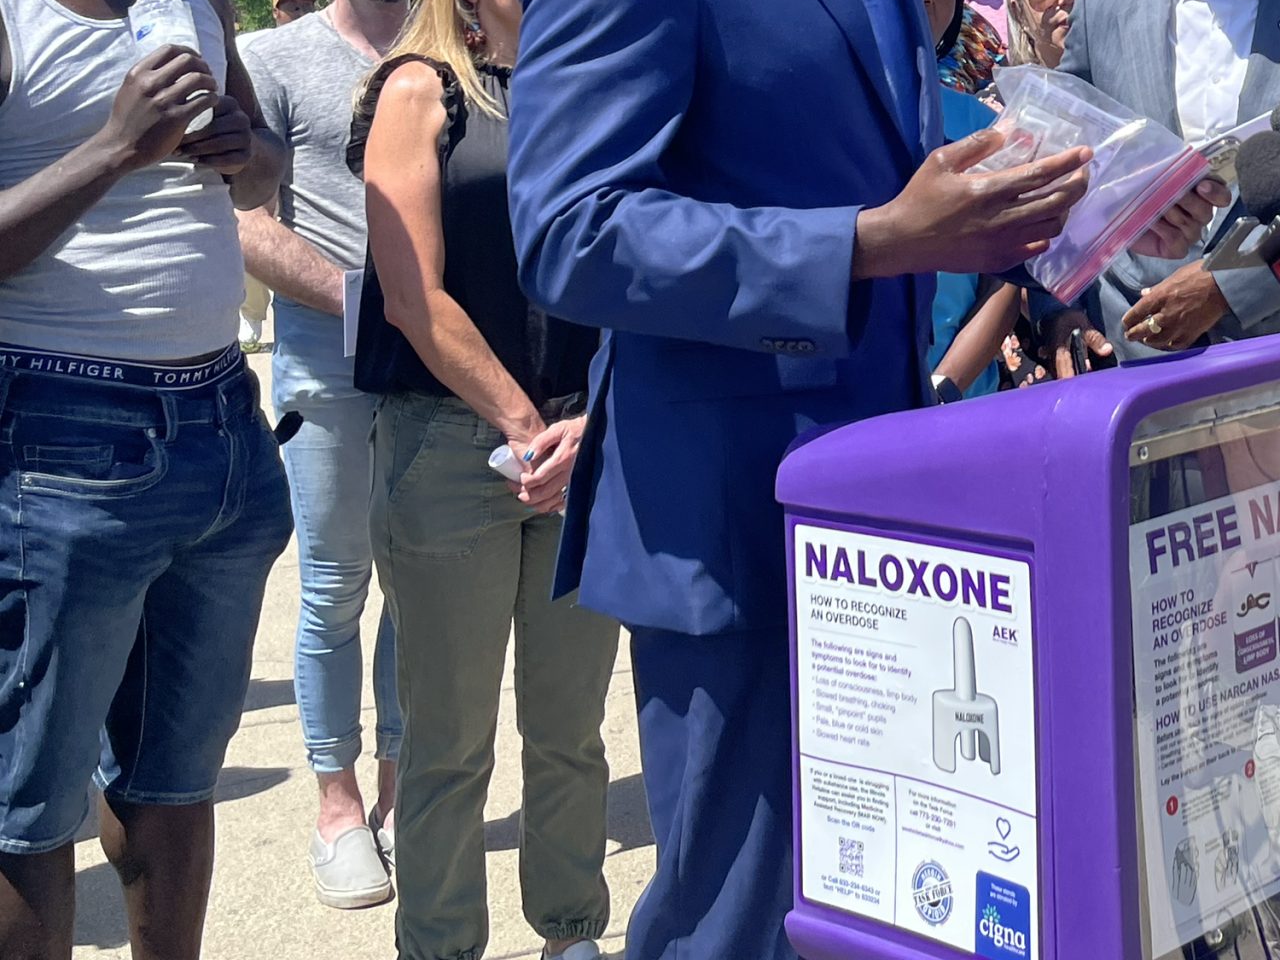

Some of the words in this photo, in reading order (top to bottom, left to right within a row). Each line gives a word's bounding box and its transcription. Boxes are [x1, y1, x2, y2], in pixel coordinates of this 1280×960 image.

[30, 358, 124, 380] HILFIGER
[153, 366, 210, 384] TOMMY
[1145, 504, 1242, 575] FREE
[805, 541, 1013, 615] NALOXONE
[811, 594, 833, 608] HOW
[835, 598, 849, 611] TO
[851, 601, 908, 621] RECOGNIZE
[1151, 594, 1178, 616] HOW
[1180, 589, 1195, 605] TO
[811, 609, 824, 622] AN
[826, 612, 880, 631] OVERDOSE
[1152, 599, 1214, 633] RECOGNIZE
[993, 625, 1018, 642] AEK
[1153, 633, 1169, 651] AN
[1171, 611, 1228, 643] OVERDOSE
[811, 637, 822, 649] The
[824, 640, 853, 656] following
[854, 647, 865, 656] are
[866, 649, 883, 660] signs
[885, 653, 897, 663] and
[1257, 648, 1270, 660] BODY
[812, 651, 844, 664] symptoms
[845, 656, 852, 665] to
[853, 658, 867, 668] look
[869, 661, 878, 670] for
[879, 663, 887, 672] to
[888, 665, 912, 679] identify
[817, 664, 844, 674] potential
[1154, 658, 1166, 669] The
[1155, 668, 1172, 682] signs
[816, 676, 830, 686] Loss
[831, 678, 837, 687] of
[887, 689, 900, 701] limp
[901, 692, 918, 706] body
[1155, 684, 1163, 694] to
[1163, 678, 1178, 691] look
[816, 688, 838, 701] Slowed
[871, 700, 897, 715] choking
[1156, 710, 1180, 731] HOW
[1184, 704, 1197, 719] TO
[1199, 696, 1218, 713] USE
[1220, 680, 1260, 704] NARCAN
[832, 719, 846, 729] blue
[855, 724, 869, 734] cold
[870, 727, 884, 736] skin
[868, 713, 887, 724] pupils
[955, 712, 985, 724] NALOXONE
[816, 728, 839, 741] Slowed
[840, 734, 856, 745] heart
[858, 738, 871, 748] rate
[1161, 775, 1171, 787] Lay
[1171, 773, 1180, 782] the
[1206, 756, 1218, 766] their
[913, 891, 931, 905] TASK
[932, 883, 953, 901] FORCE
[980, 915, 1026, 950] cigna
